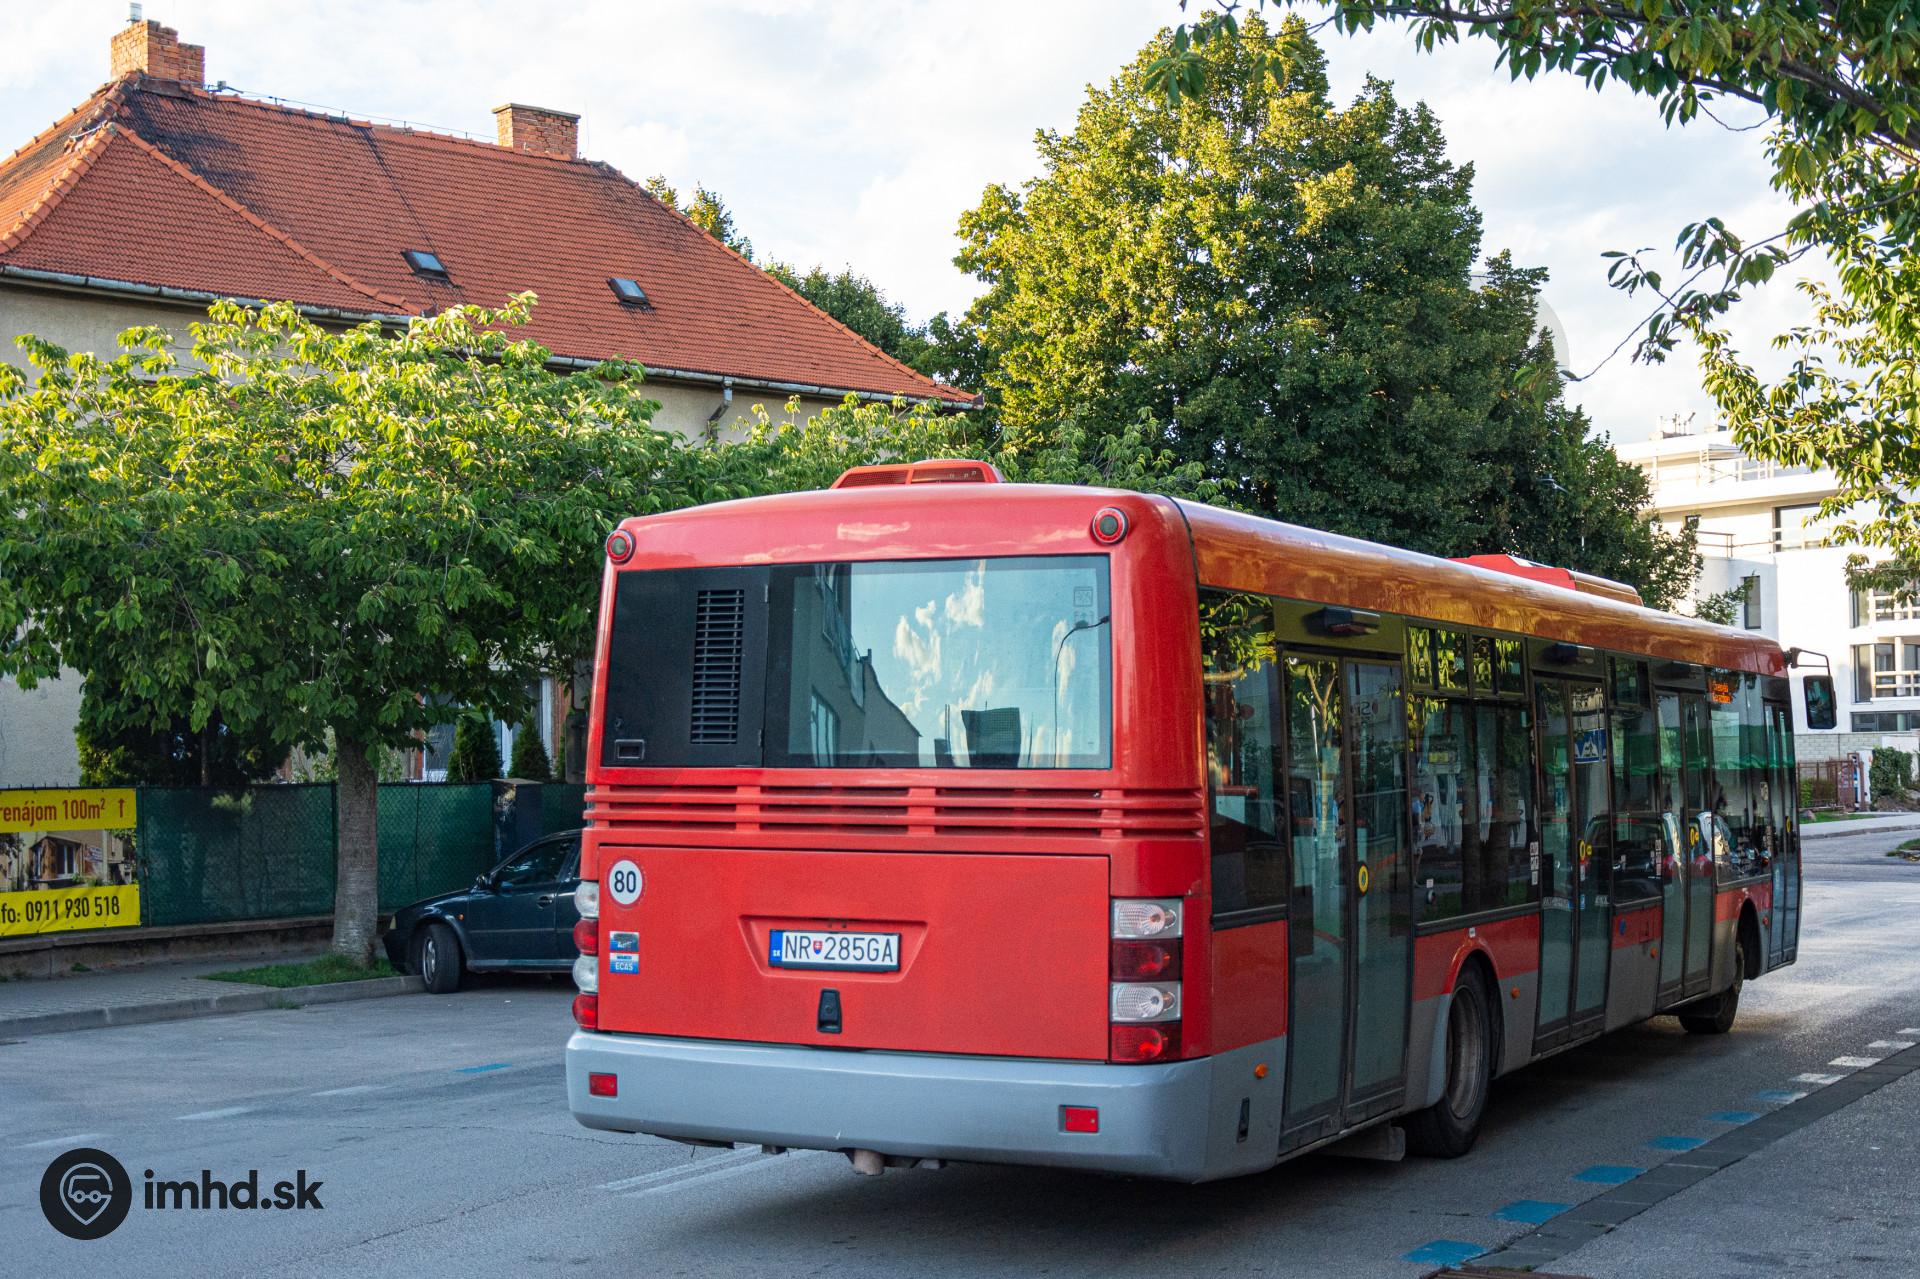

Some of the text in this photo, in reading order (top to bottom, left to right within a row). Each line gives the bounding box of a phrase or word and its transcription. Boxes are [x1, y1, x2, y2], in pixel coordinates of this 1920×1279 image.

[614, 870, 636, 893] 80
[1, 896, 120, 924] fo: 0911 930 518
[785, 935, 893, 962] NR 285GA
